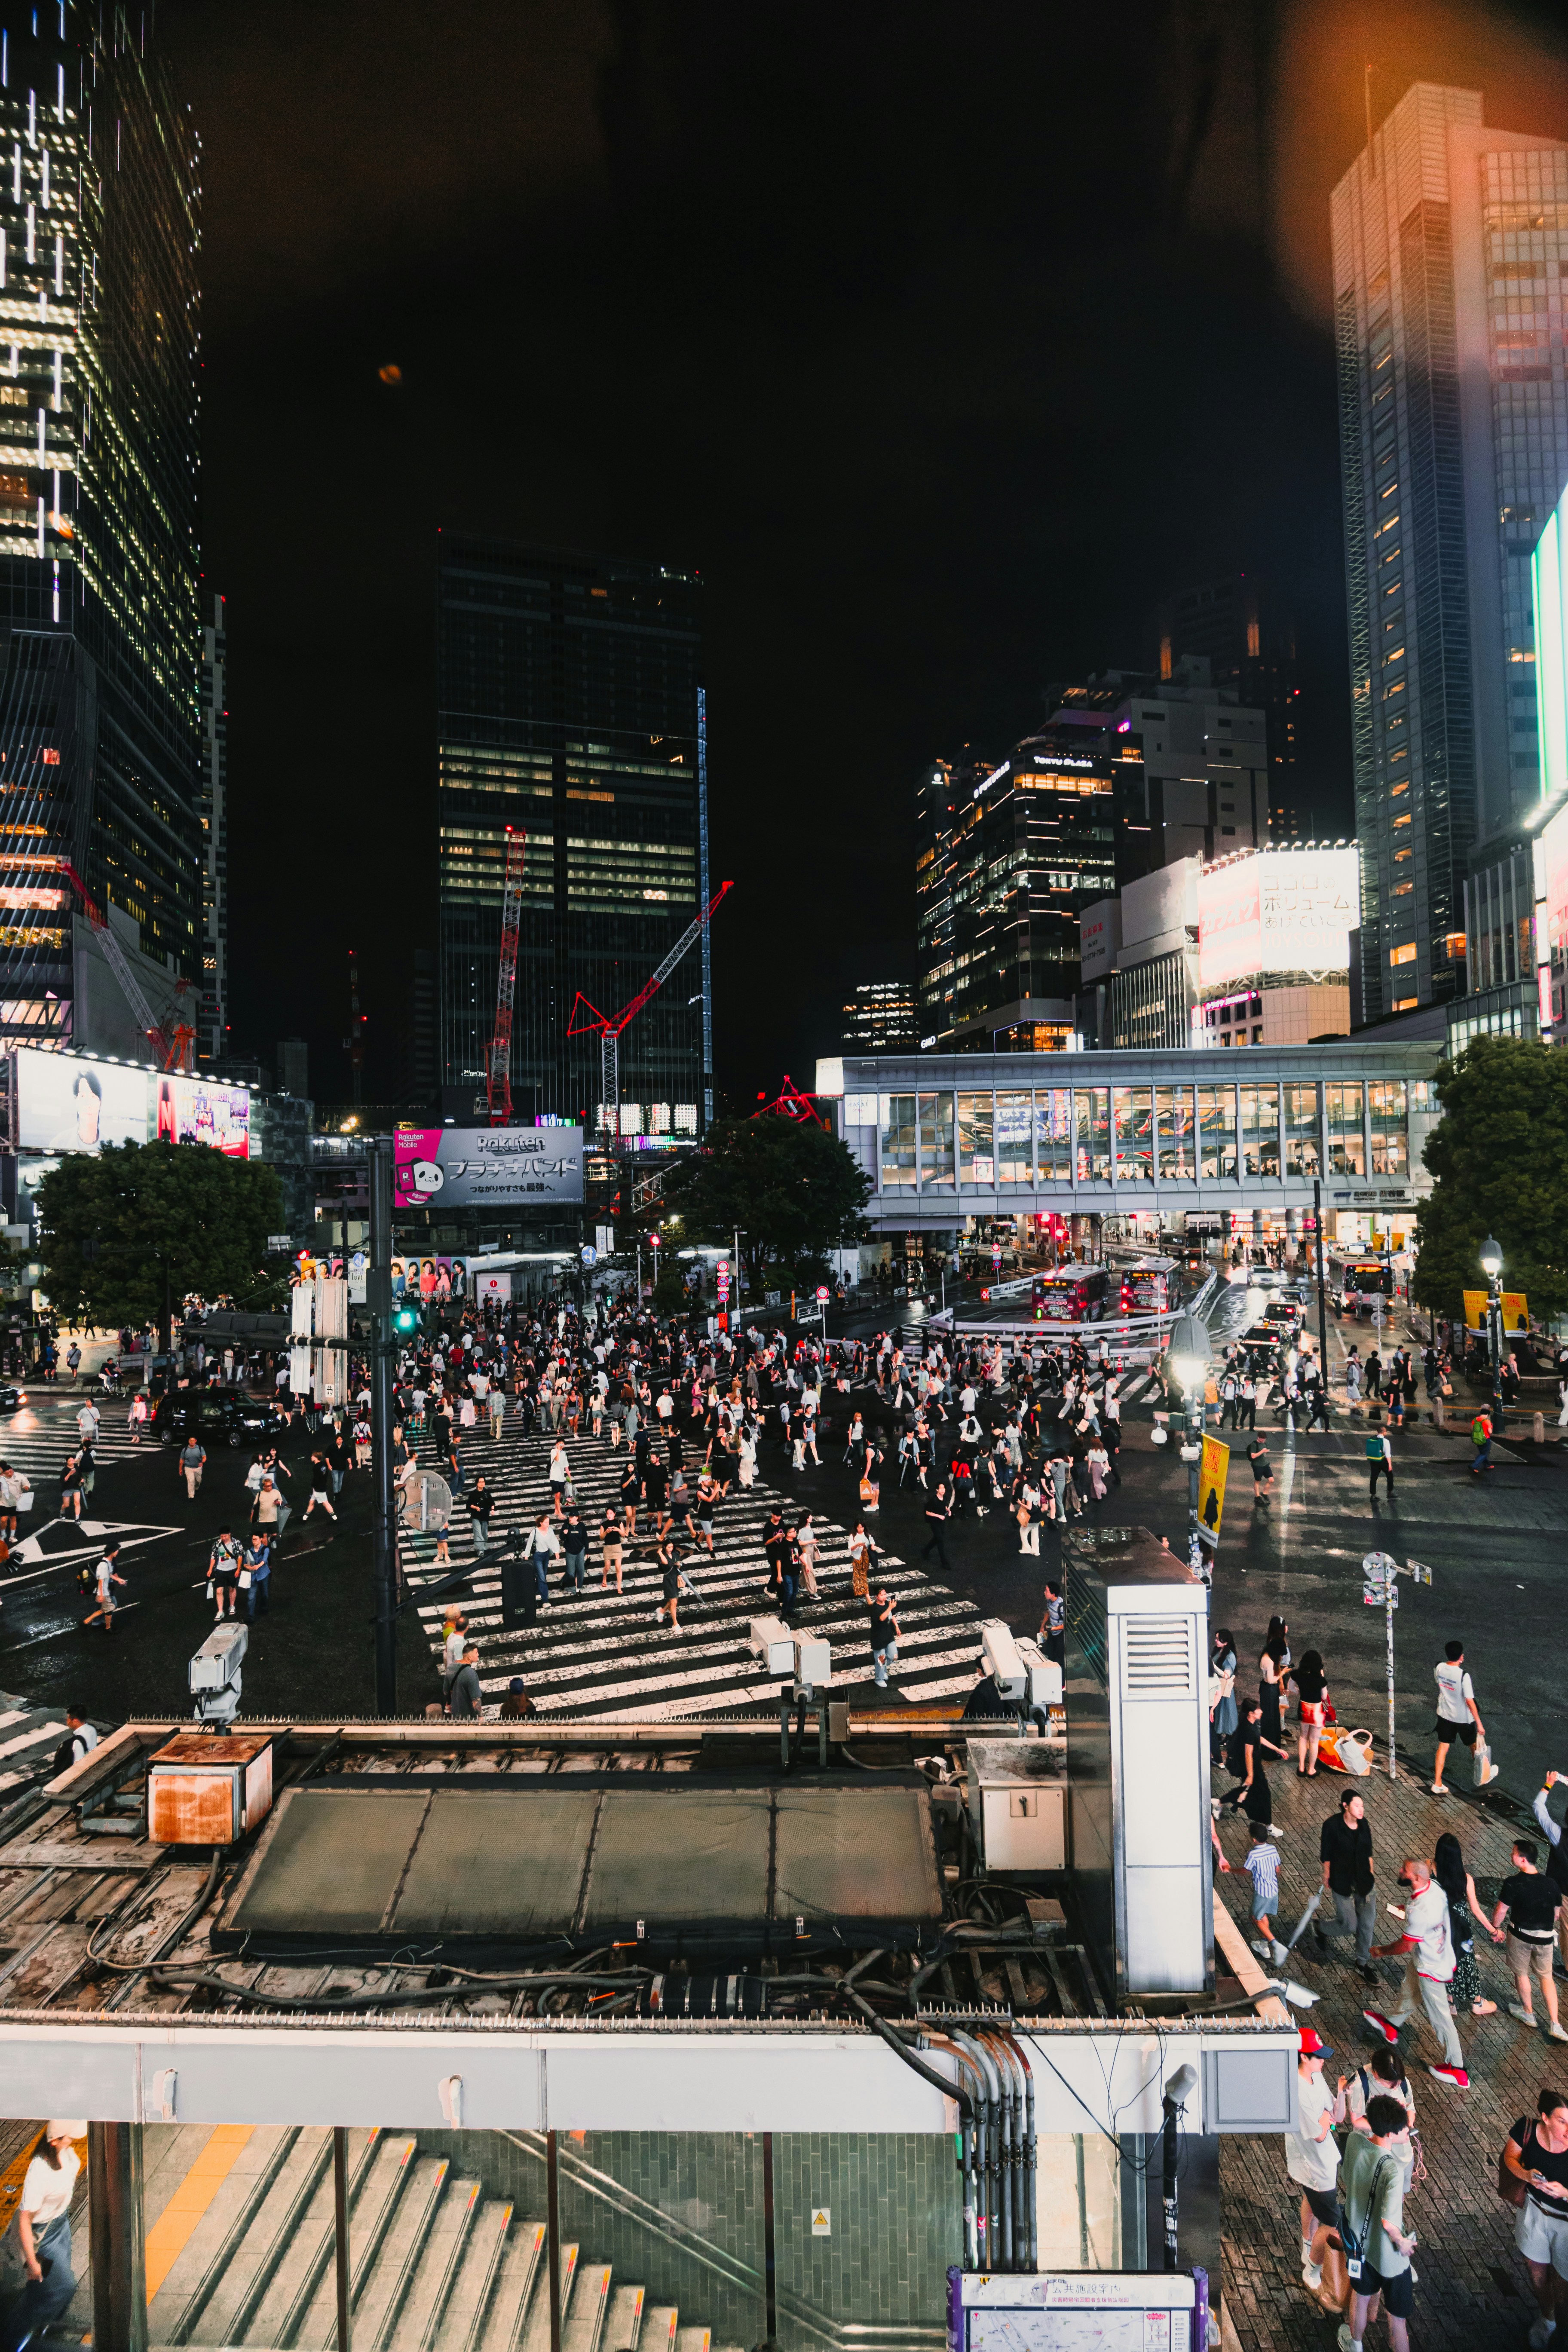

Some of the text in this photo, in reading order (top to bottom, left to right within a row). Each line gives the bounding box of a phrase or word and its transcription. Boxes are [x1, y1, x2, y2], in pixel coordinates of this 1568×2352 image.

[1034, 756, 1093, 767] TOKYU PLAZA
[979, 761, 1011, 794] FUKURAS
[1264, 874, 1335, 891] ココロの
[1265, 894, 1357, 911] ボリューム、
[1201, 895, 1258, 934] カラオケ
[921, 1035, 936, 1049] GMO
[161, 1100, 172, 1130] N
[398, 1134, 424, 1142] Rakuten
[477, 1134, 546, 1156] Rakuten
[402, 1173, 410, 1181] R
[447, 1158, 578, 1180] プラチナバンド
[470, 1182, 556, 1193] つながりやすさも最強へ。
